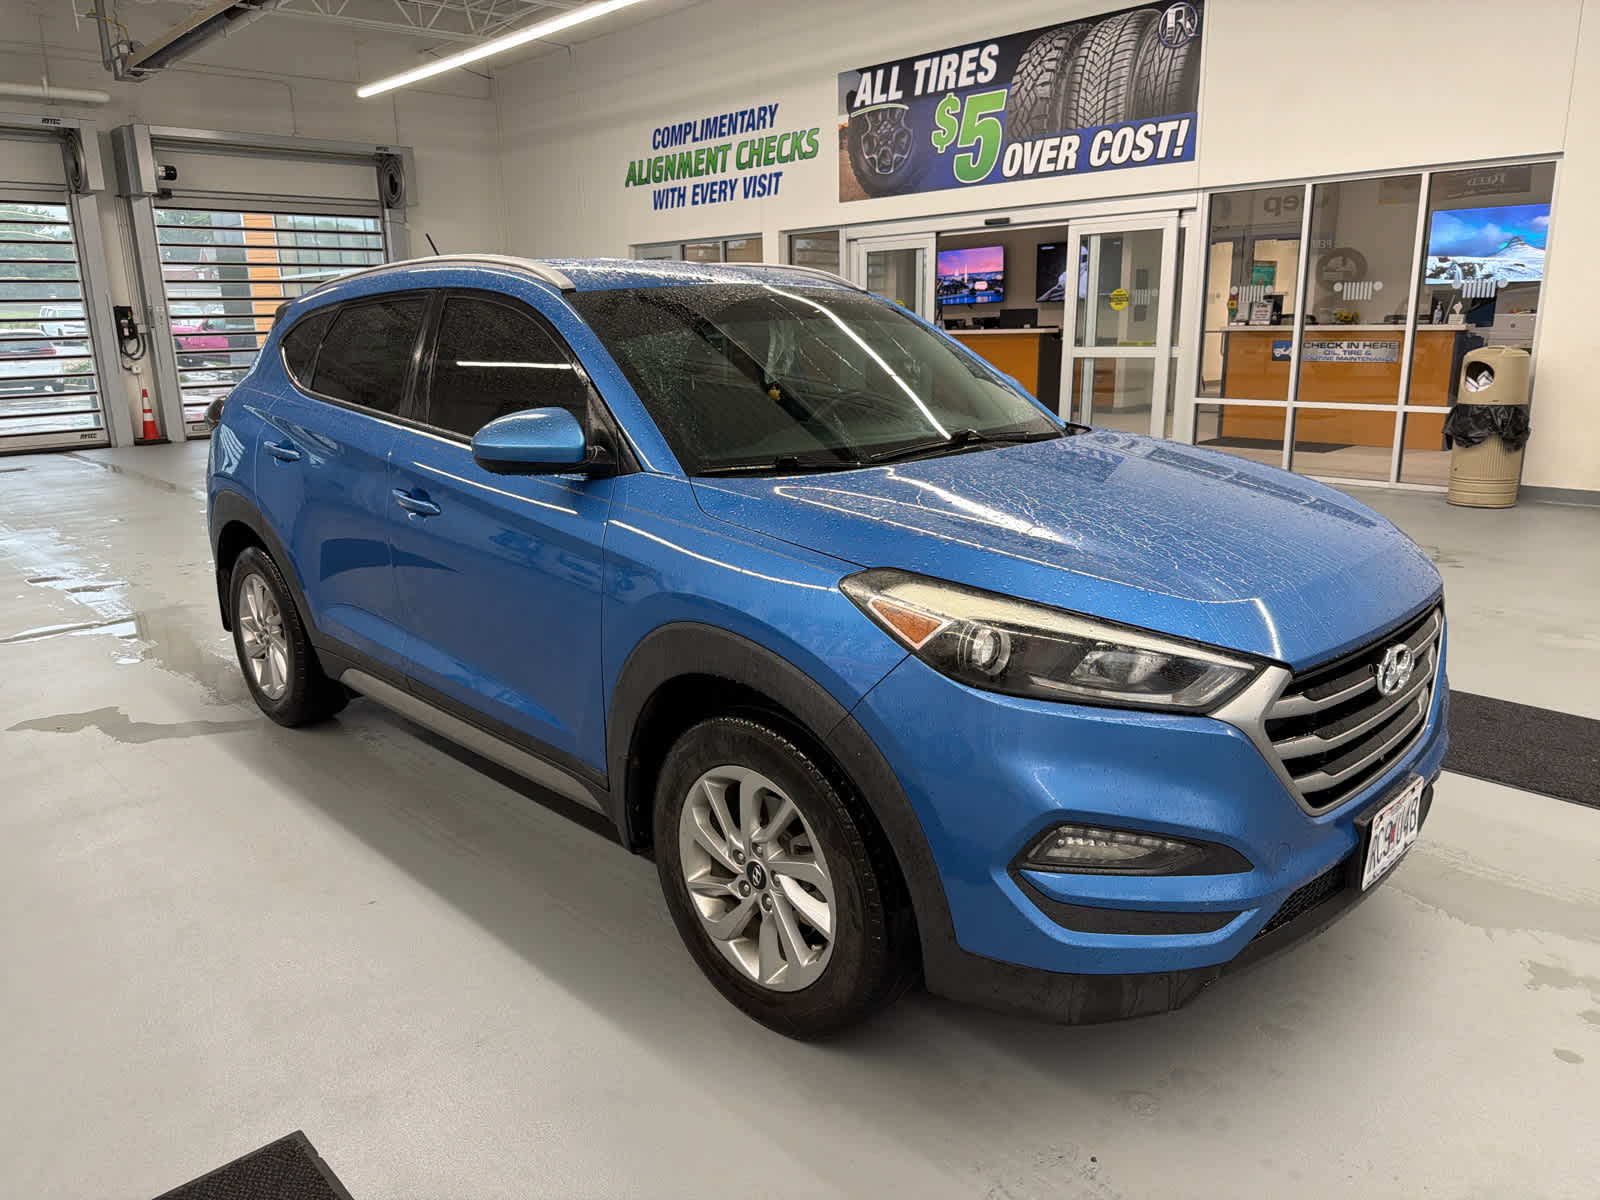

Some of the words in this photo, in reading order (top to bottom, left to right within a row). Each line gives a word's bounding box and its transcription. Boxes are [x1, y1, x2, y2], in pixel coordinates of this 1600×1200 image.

[853, 65, 904, 108] ALL
[912, 43, 1000, 98] TIRES
[652, 103, 779, 150] COMPLIMENTARY
[931, 88, 1008, 185] $5
[1001, 133, 1081, 179] OVER
[1088, 118, 1191, 168] COST!
[625, 143, 732, 187] ALIGNMENT
[735, 127, 821, 170] CHECKS
[652, 184, 686, 211] WITH
[691, 178, 738, 206] EVERY
[742, 171, 783, 199] VISIT
[1303, 342, 1343, 350] CHECK
